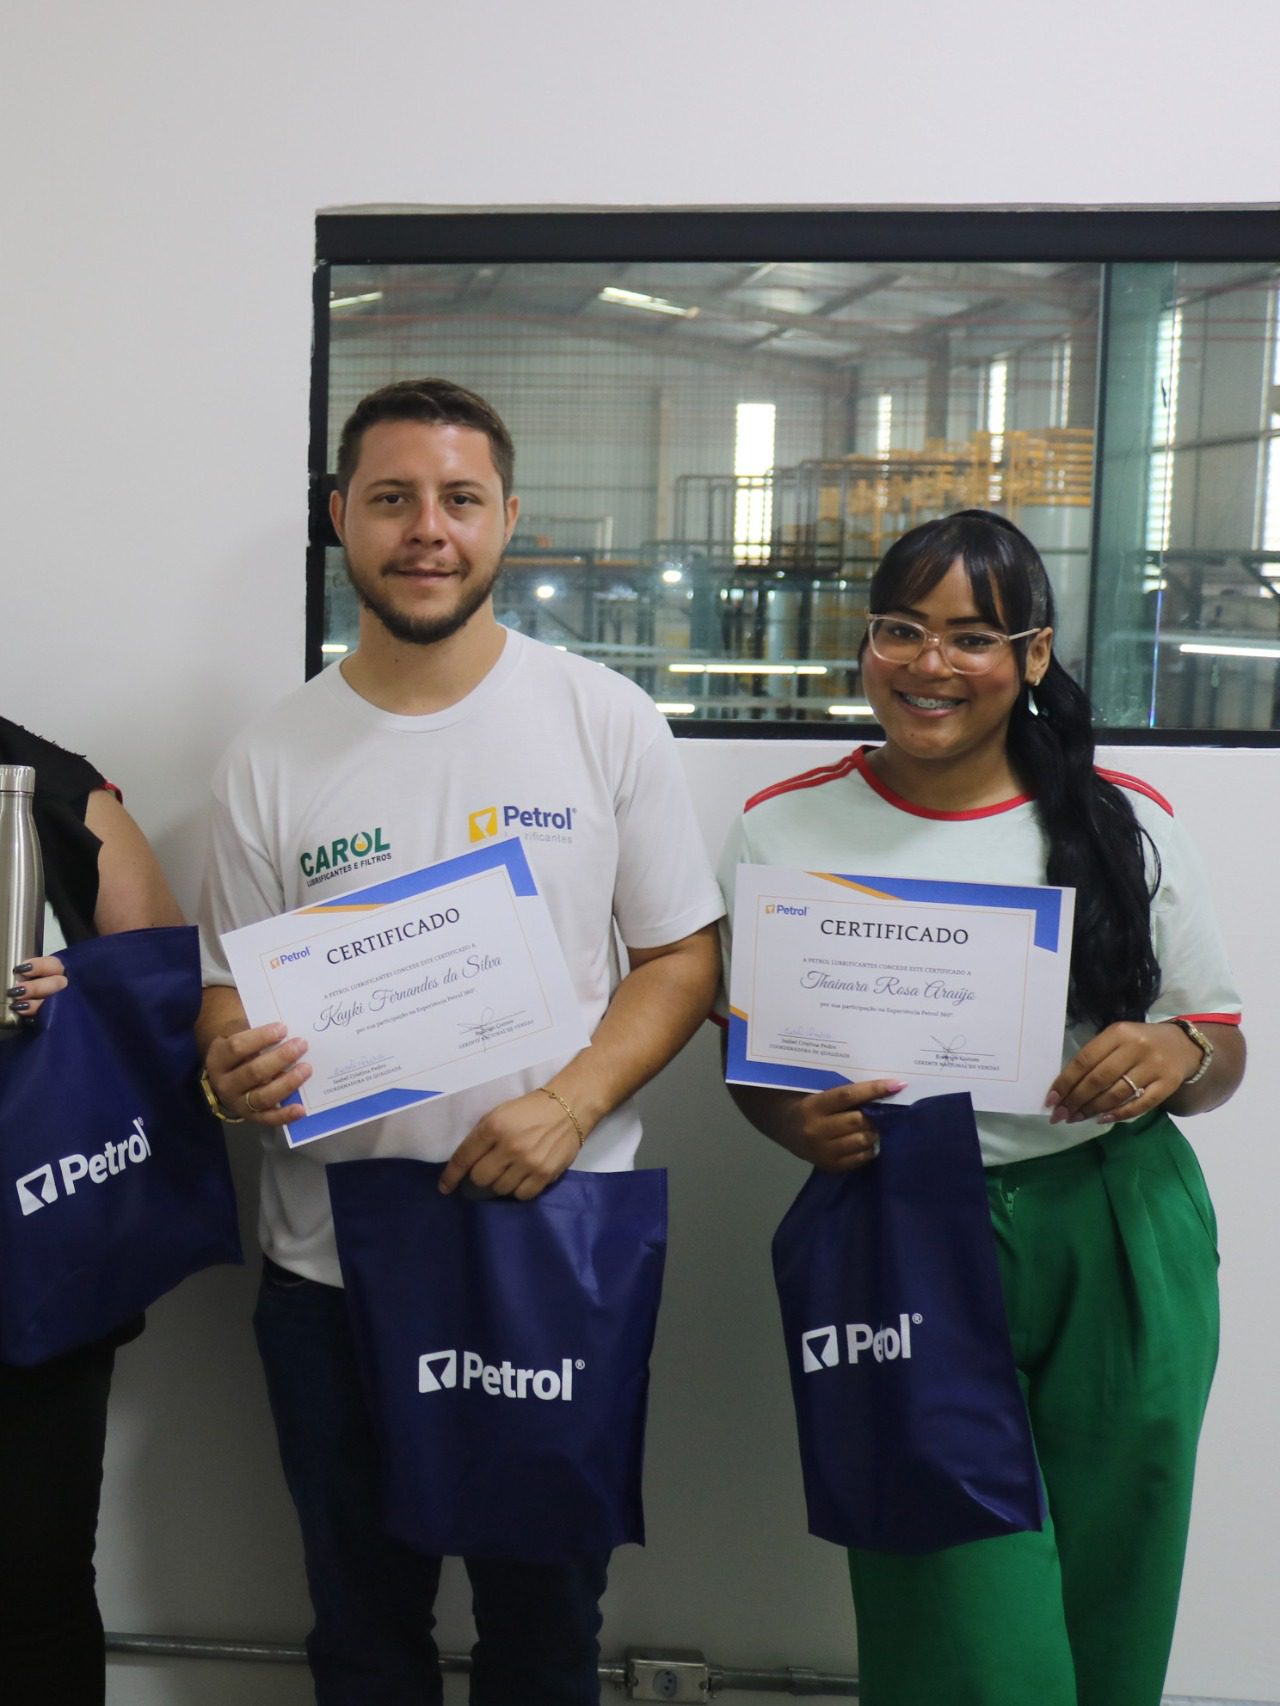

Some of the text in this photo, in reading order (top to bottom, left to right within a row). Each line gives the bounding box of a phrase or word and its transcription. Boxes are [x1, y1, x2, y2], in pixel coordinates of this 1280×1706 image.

[300, 827, 391, 877] CAROL
[307, 853, 392, 887] LUBRIFICANTES E FILTROS
[327, 908, 459, 964] CERTIFICADO
[820, 920, 968, 944] CERTIFICADO
[319, 955, 500, 1032] Kayki Fernandes da Silva
[800, 970, 974, 1006] Thainara Rosa Araújo
